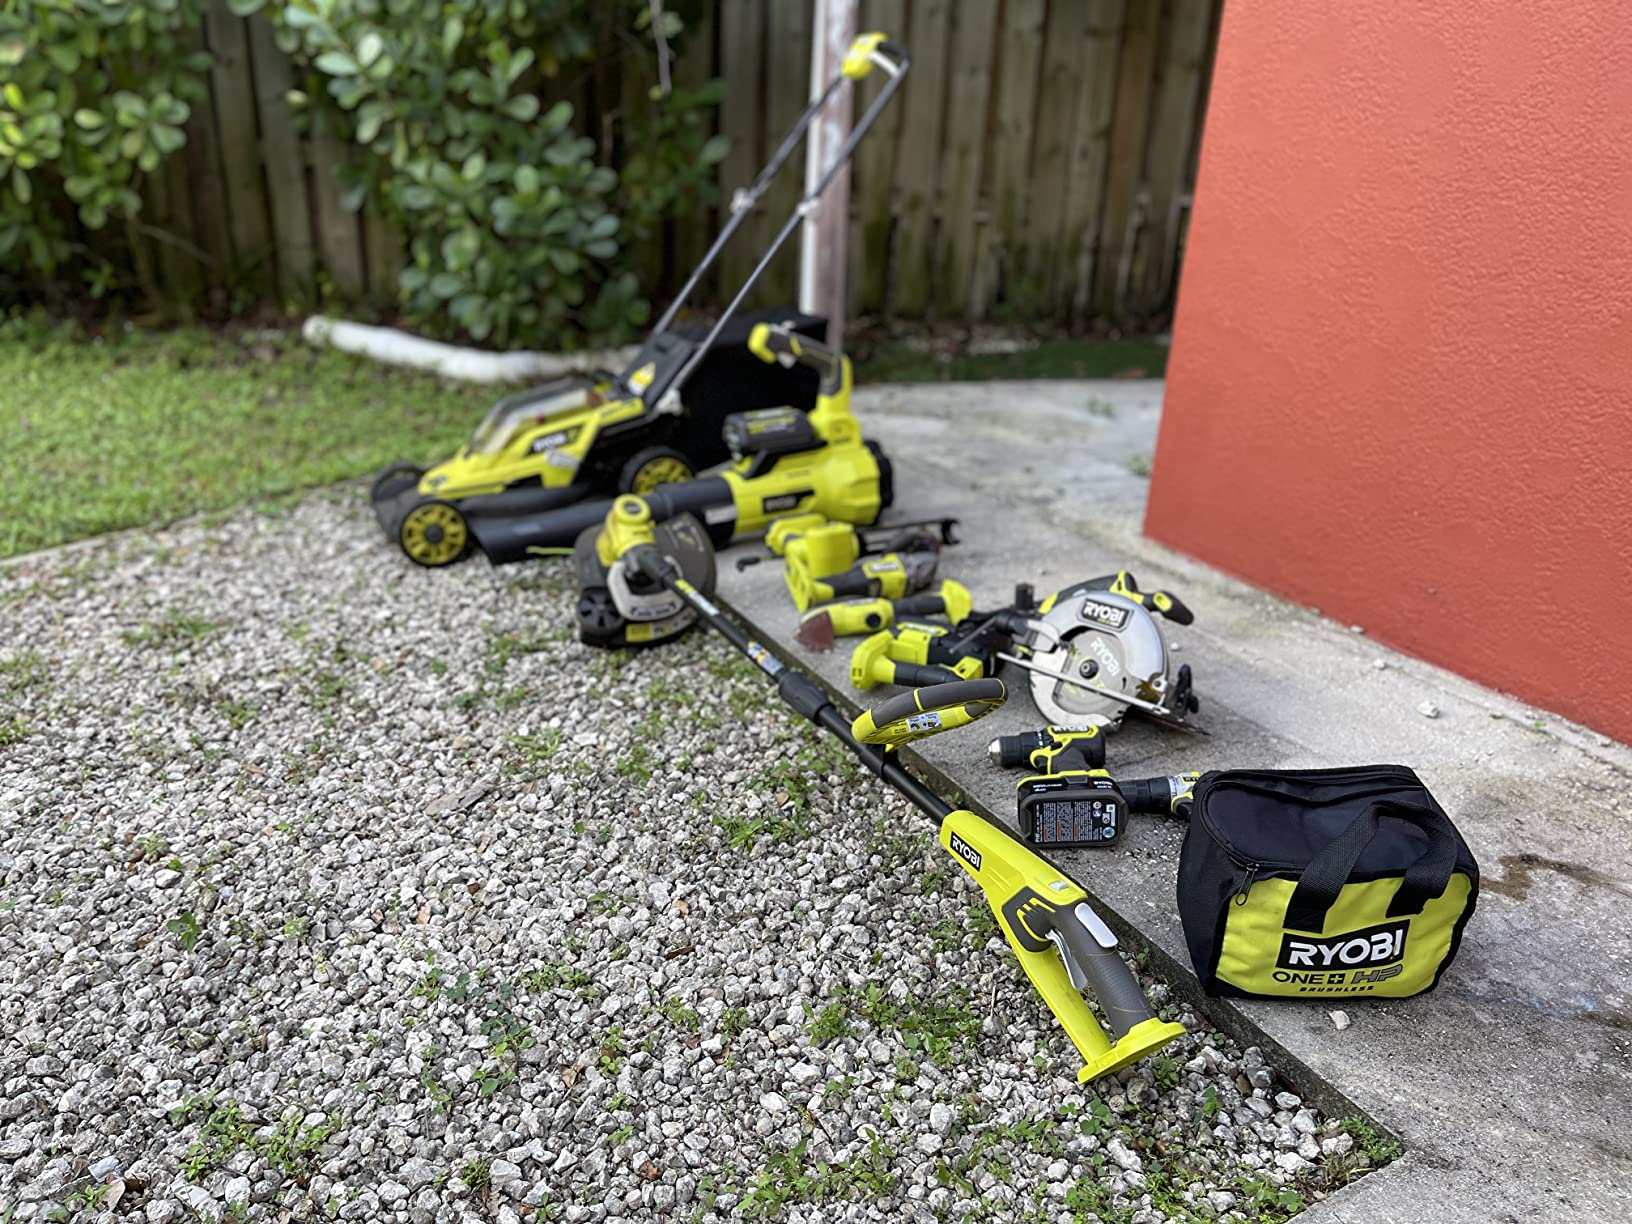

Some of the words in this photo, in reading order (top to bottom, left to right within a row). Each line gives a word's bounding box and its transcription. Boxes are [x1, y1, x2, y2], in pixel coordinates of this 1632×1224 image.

[1083, 601, 1126, 625] RYOBI
[1090, 636, 1121, 677] RYOBI
[952, 834, 981, 868] RYOBI
[1288, 929, 1404, 966] RYOBI
[1350, 963, 1403, 985] HP
[1299, 985, 1375, 993] BRUSHLESS
